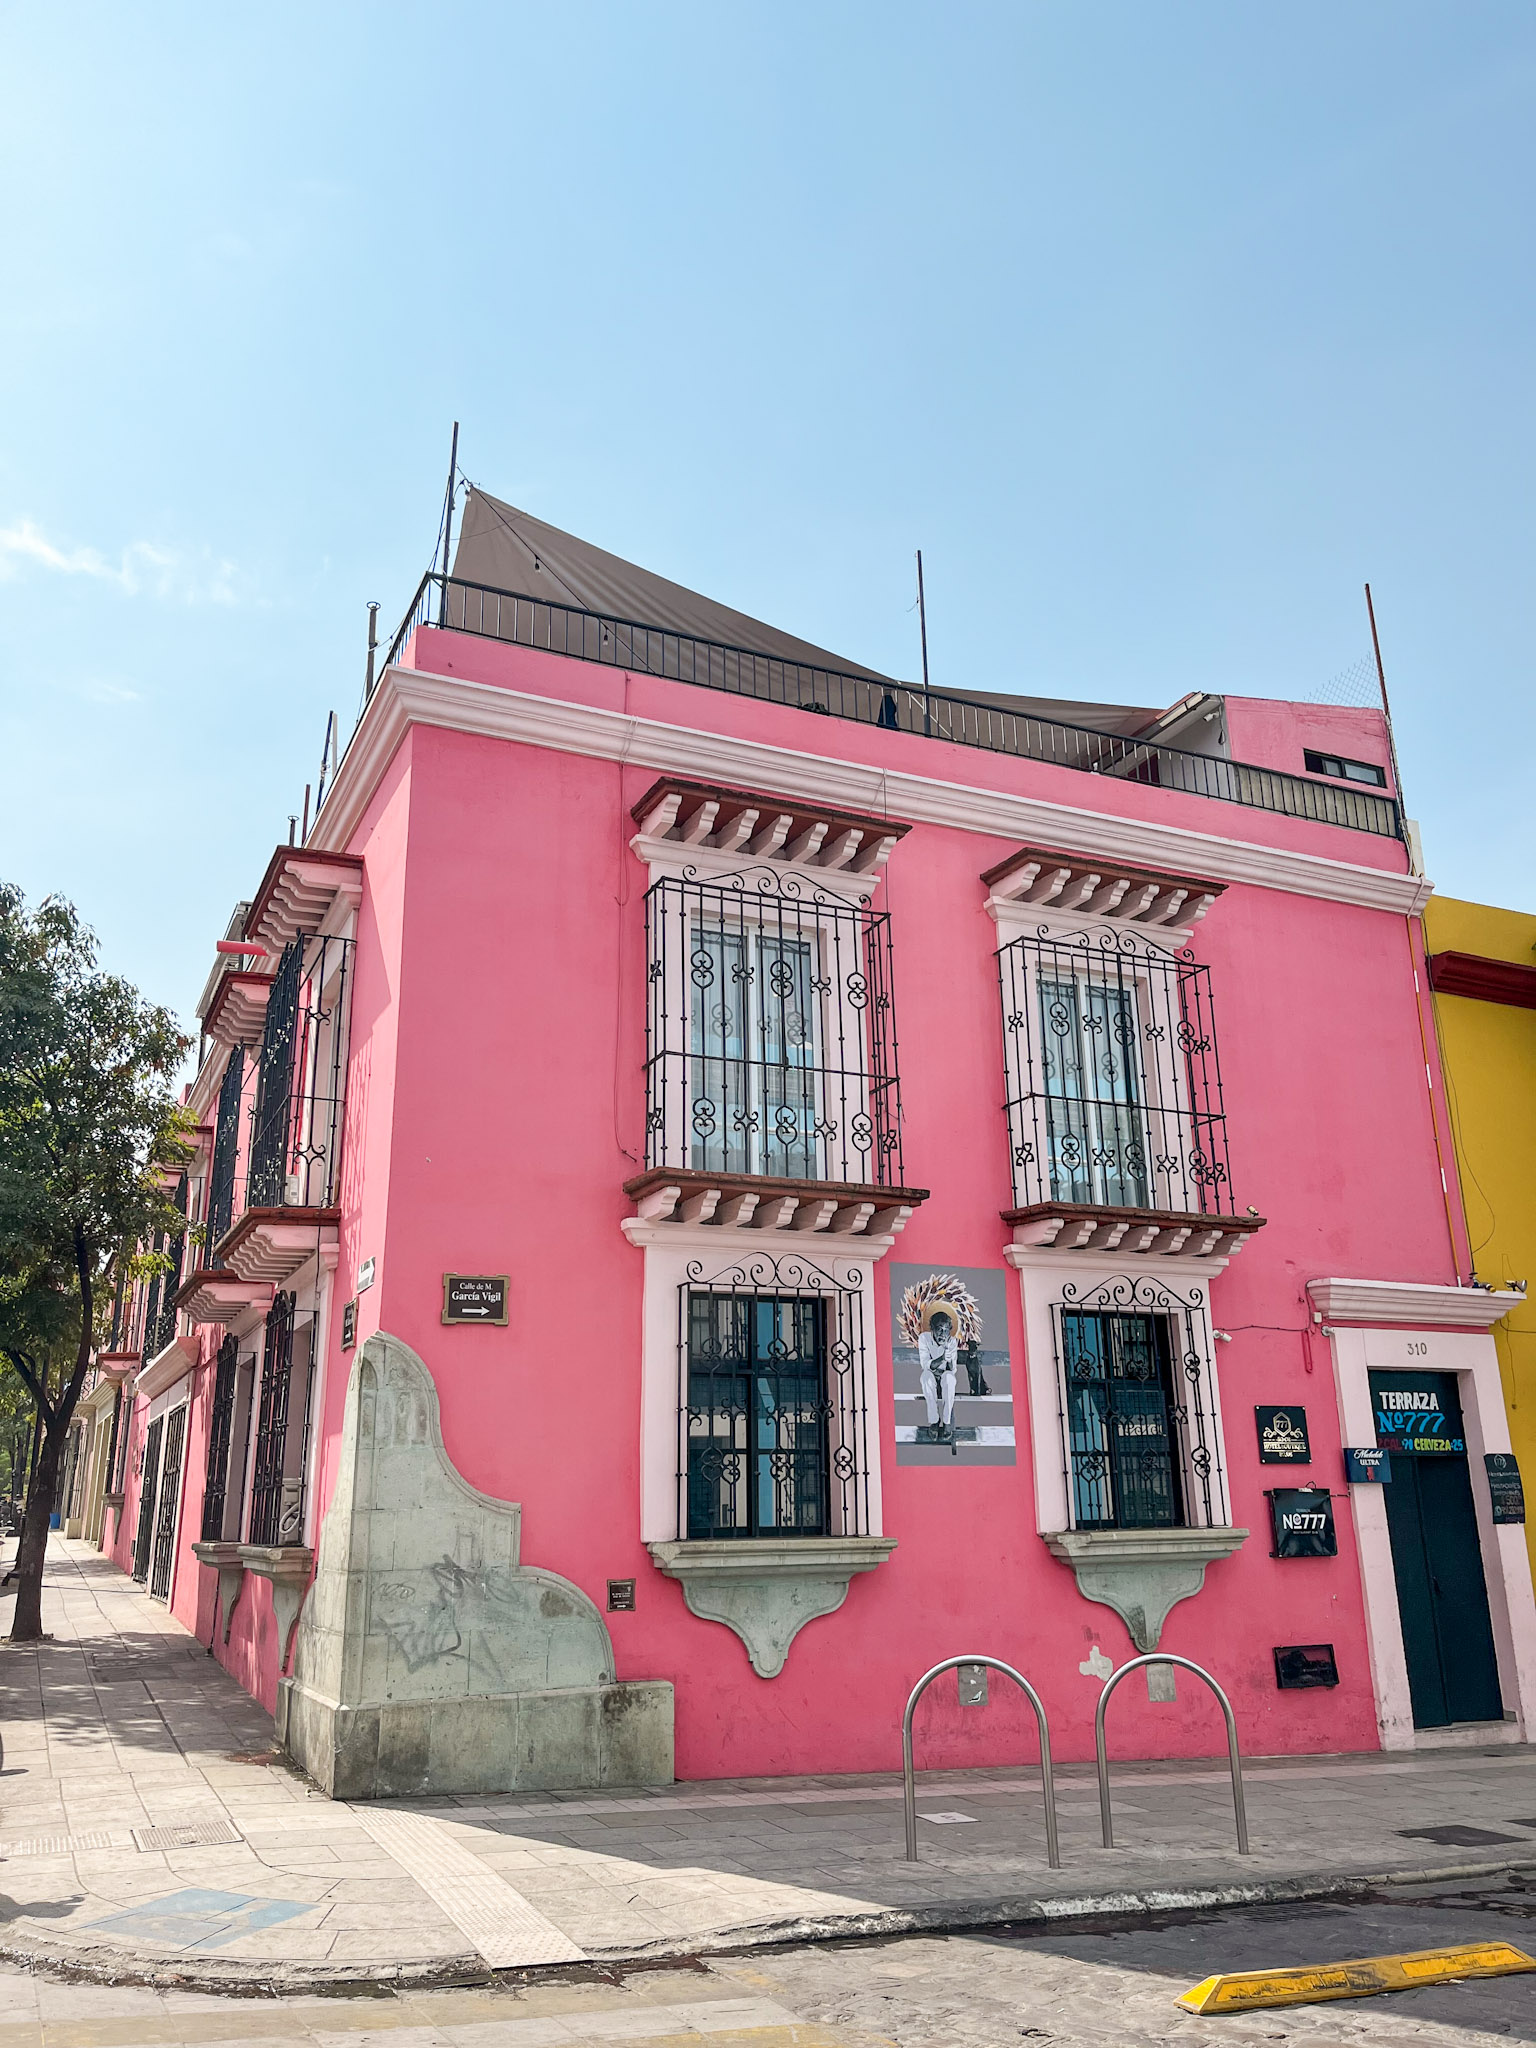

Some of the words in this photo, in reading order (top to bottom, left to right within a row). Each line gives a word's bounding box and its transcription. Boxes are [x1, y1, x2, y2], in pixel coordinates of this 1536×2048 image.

[460, 1282, 475, 1290] Calle
[452, 1291, 480, 1301] García
[482, 1292, 501, 1303] Vigil
[1407, 1342, 1427, 1355] 310
[1379, 1392, 1439, 1410] TERRAZA
